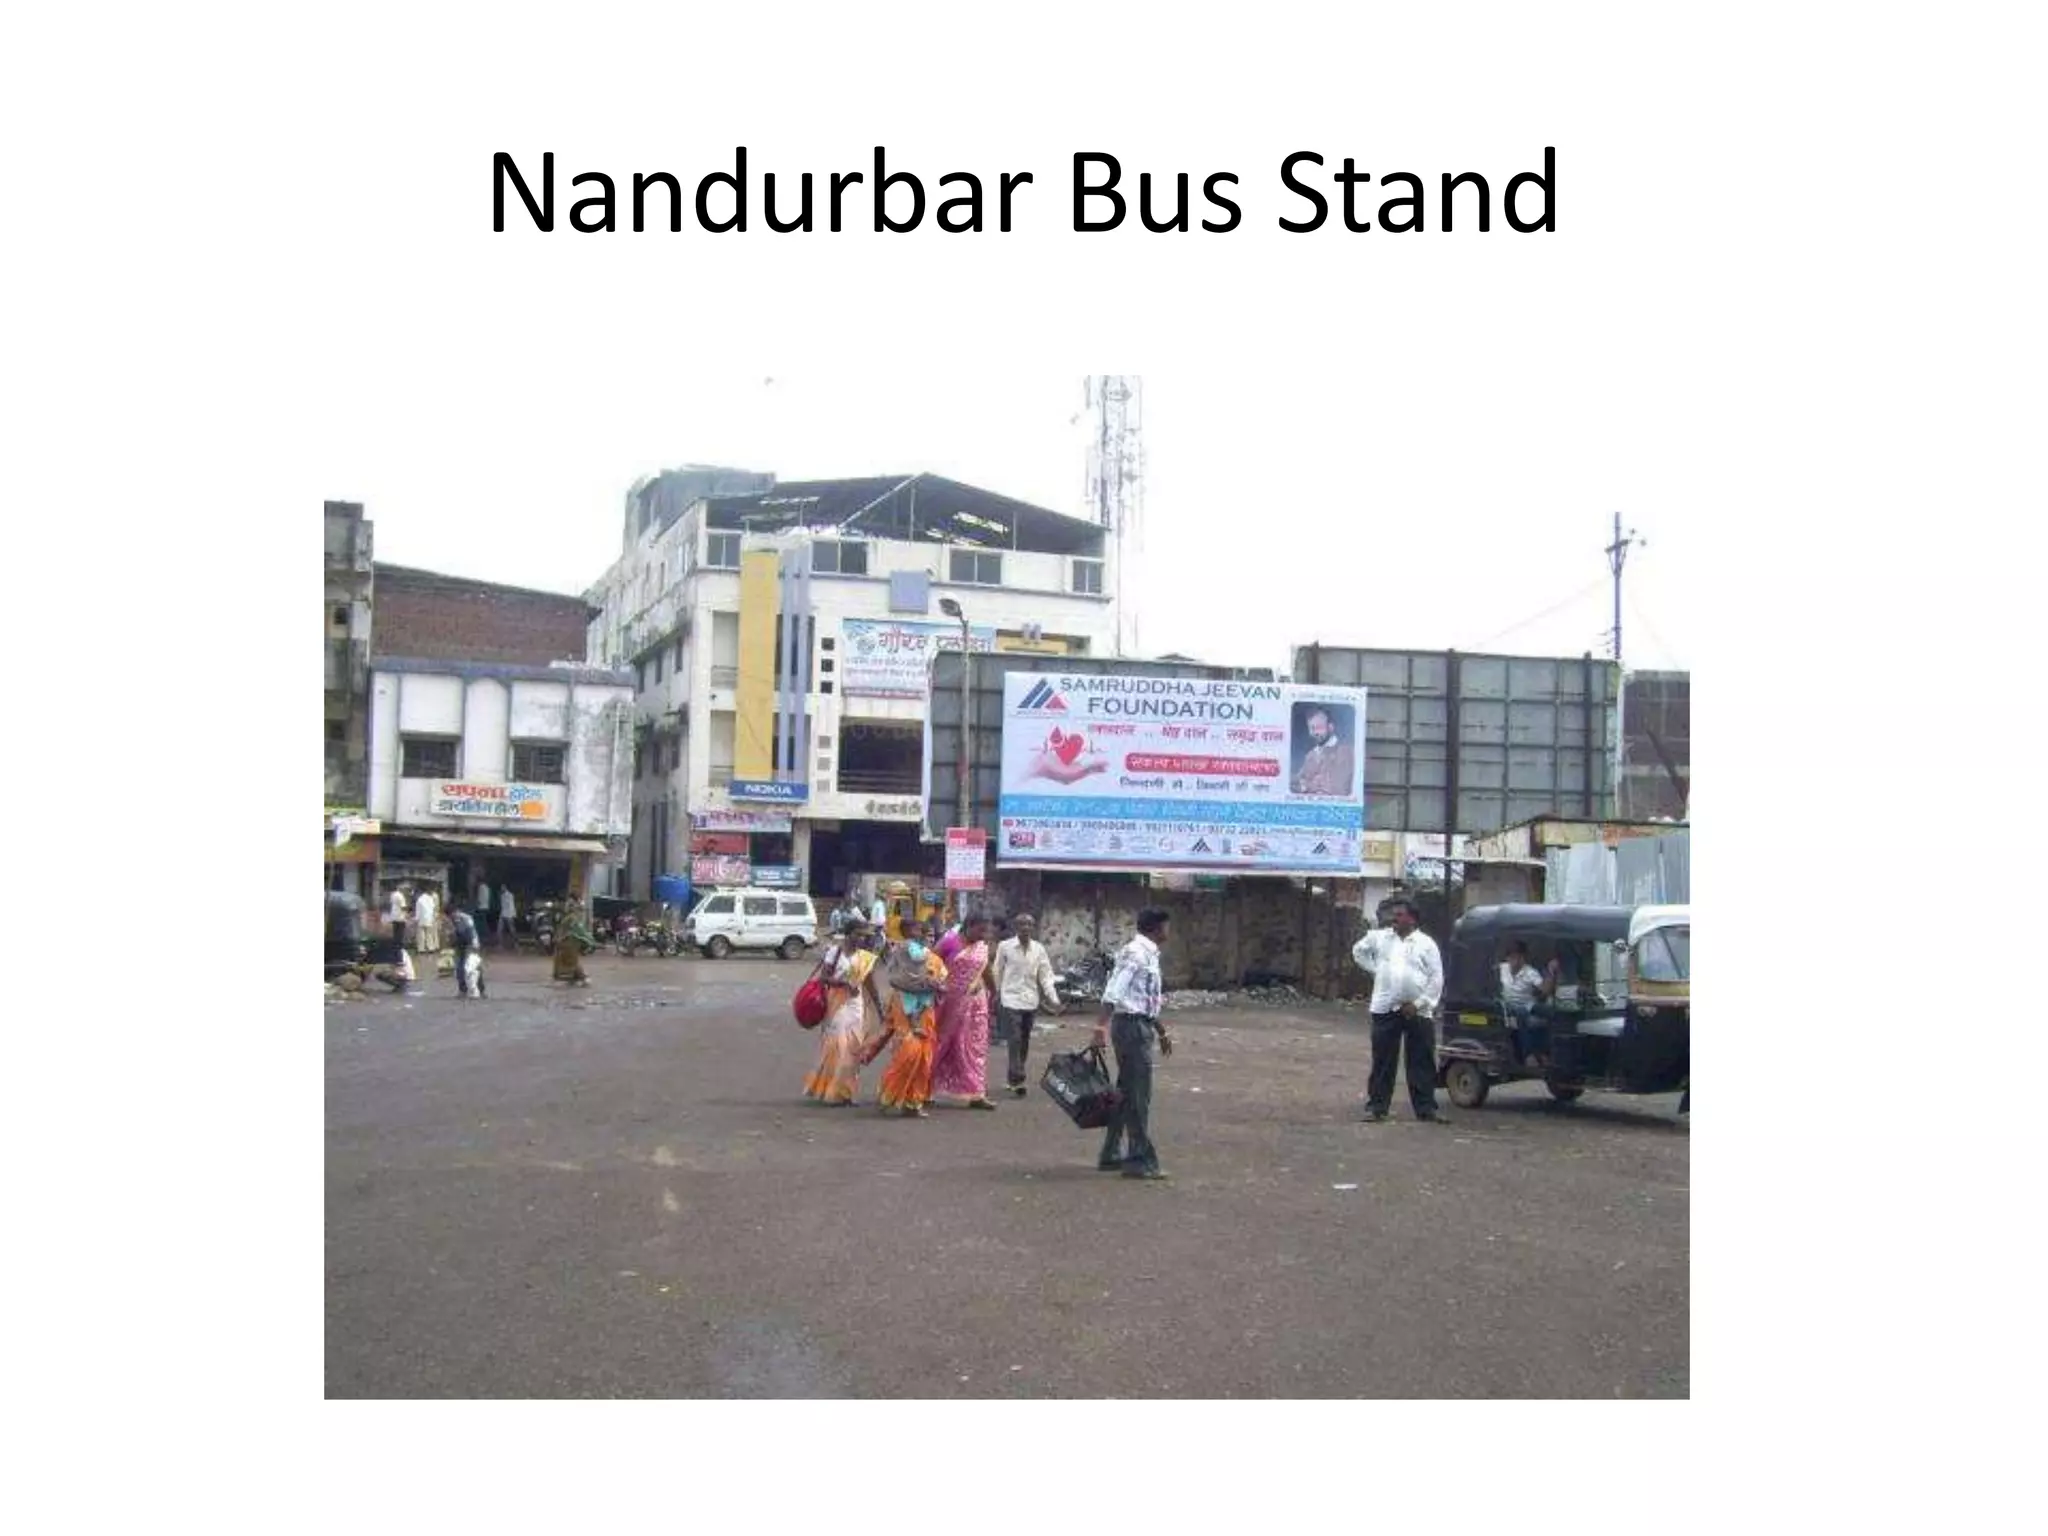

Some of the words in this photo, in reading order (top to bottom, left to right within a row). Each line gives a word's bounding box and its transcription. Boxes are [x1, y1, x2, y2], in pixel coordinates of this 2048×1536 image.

[1060, 677, 1196, 696] SAMRUDDHA
[1201, 683, 1281, 700] JEEVAN
[1087, 697, 1254, 720] FOUNDATION
[744, 784, 792, 794] NOKIA
